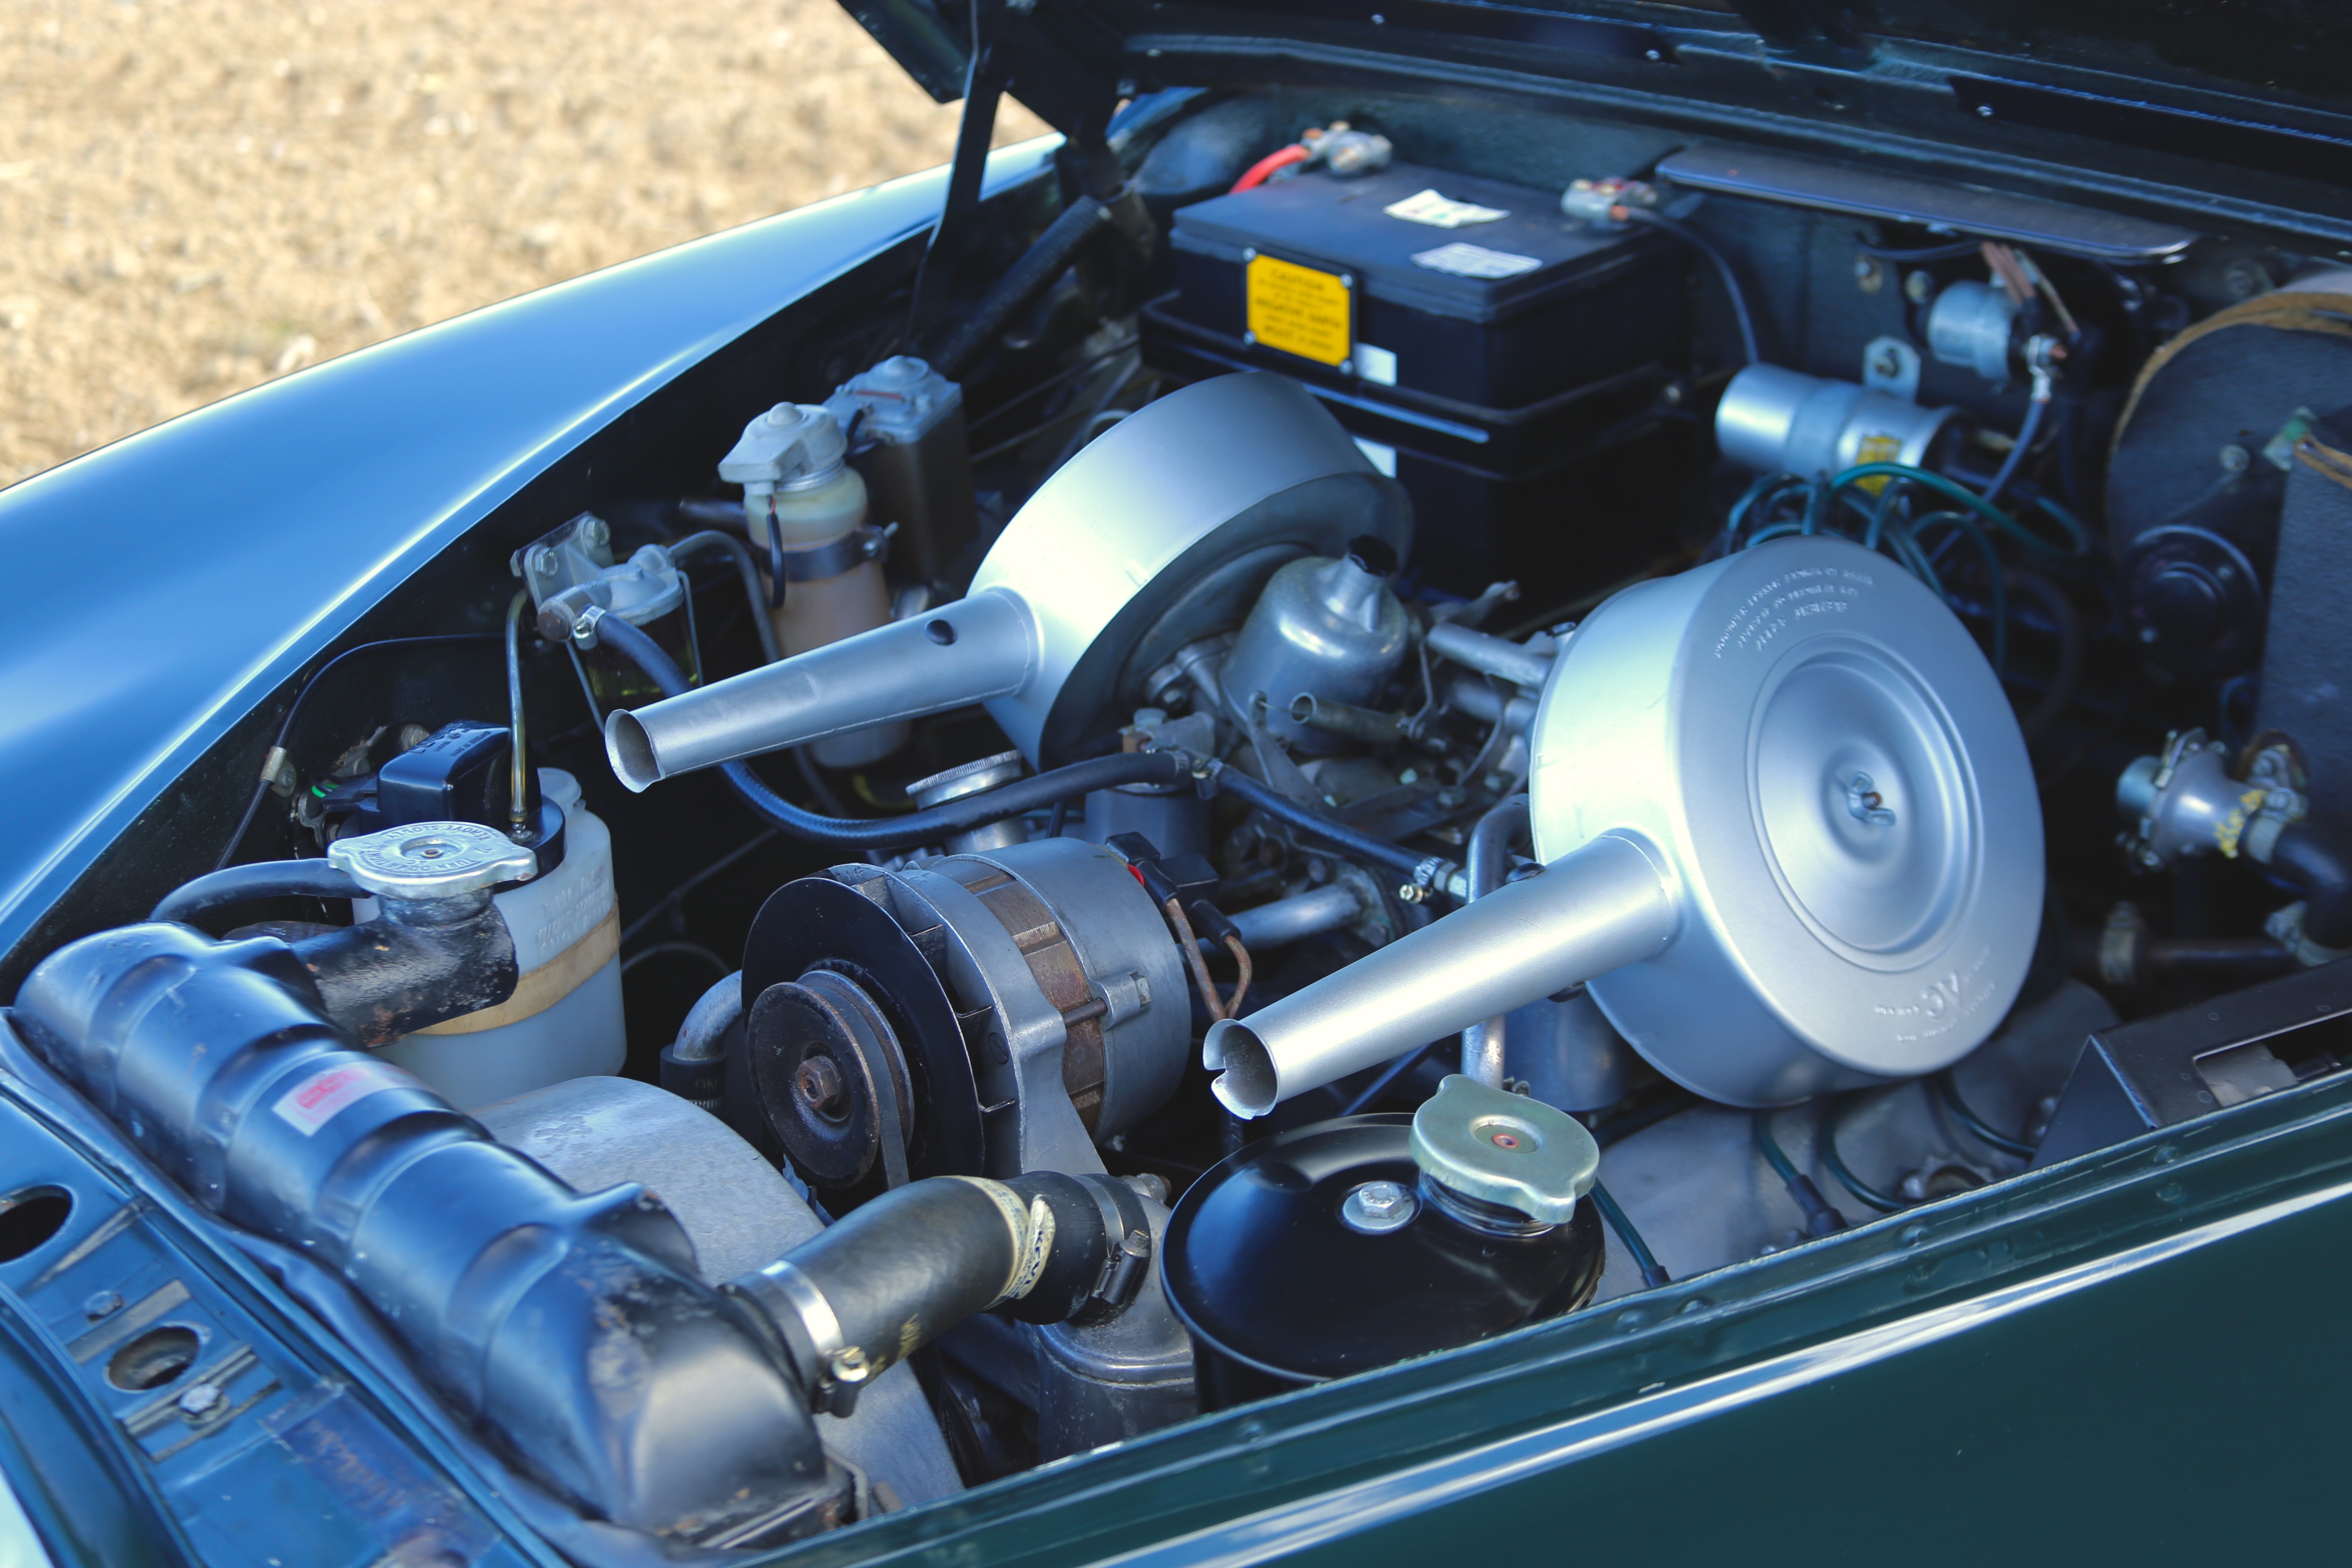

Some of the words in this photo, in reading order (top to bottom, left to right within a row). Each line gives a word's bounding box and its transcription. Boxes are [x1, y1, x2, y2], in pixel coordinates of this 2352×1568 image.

[386, 825, 439, 839] SLOWLY
[443, 824, 493, 841] REMOVE
[438, 858, 478, 871] TURN
[1920, 970, 1963, 1020] AC
